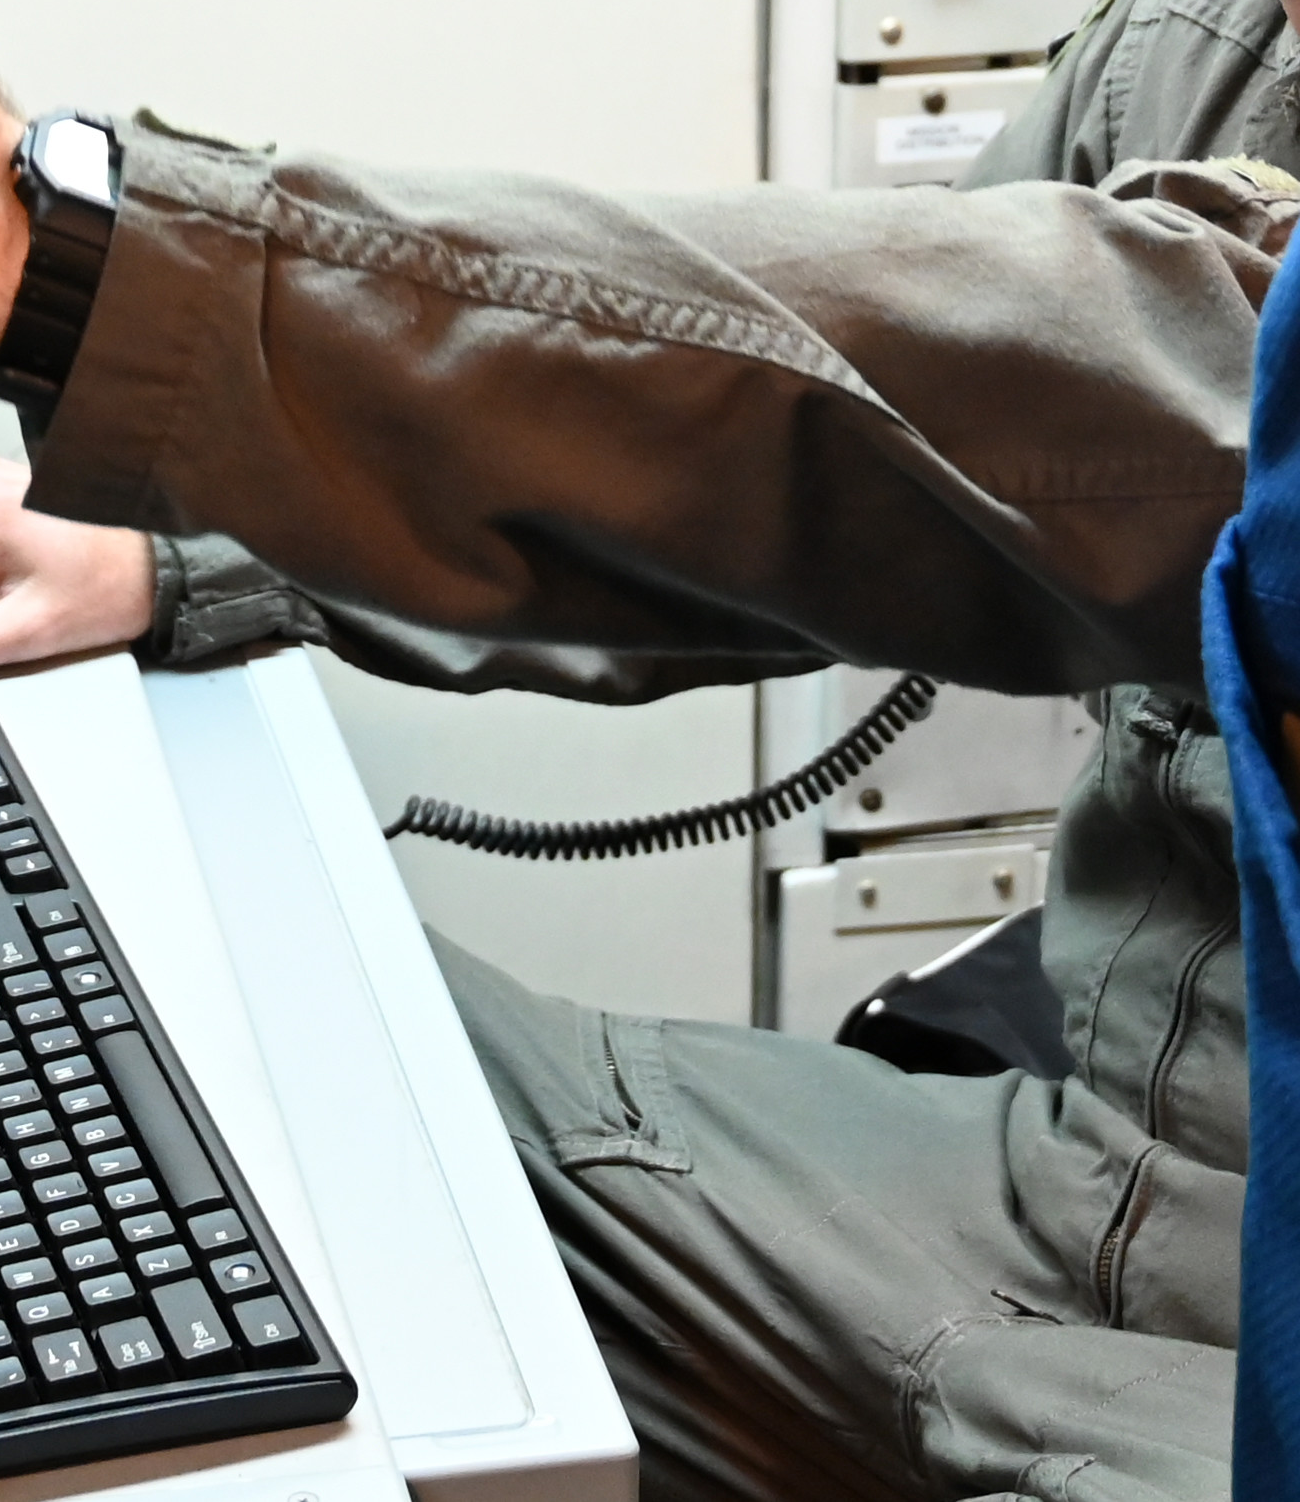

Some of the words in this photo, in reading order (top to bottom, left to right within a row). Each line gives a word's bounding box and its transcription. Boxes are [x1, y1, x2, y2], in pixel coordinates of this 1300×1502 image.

[54, 1067, 75, 1080] M
[70, 1098, 90, 1110] N
[15, 1122, 36, 1135] H
[86, 1129, 105, 1141] B
[30, 1153, 50, 1165] G
[100, 1161, 120, 1172] V
[46, 1188, 67, 1198] F
[115, 1193, 136, 1205] C
[60, 1219, 80, 1231] D
[132, 1225, 154, 1238] X
[75, 1254, 95, 1266] S
[148, 1258, 170, 1272] Z
[12, 1271, 34, 1285] W
[92, 1286, 113, 1299] A
[28, 1305, 50, 1319] Q
